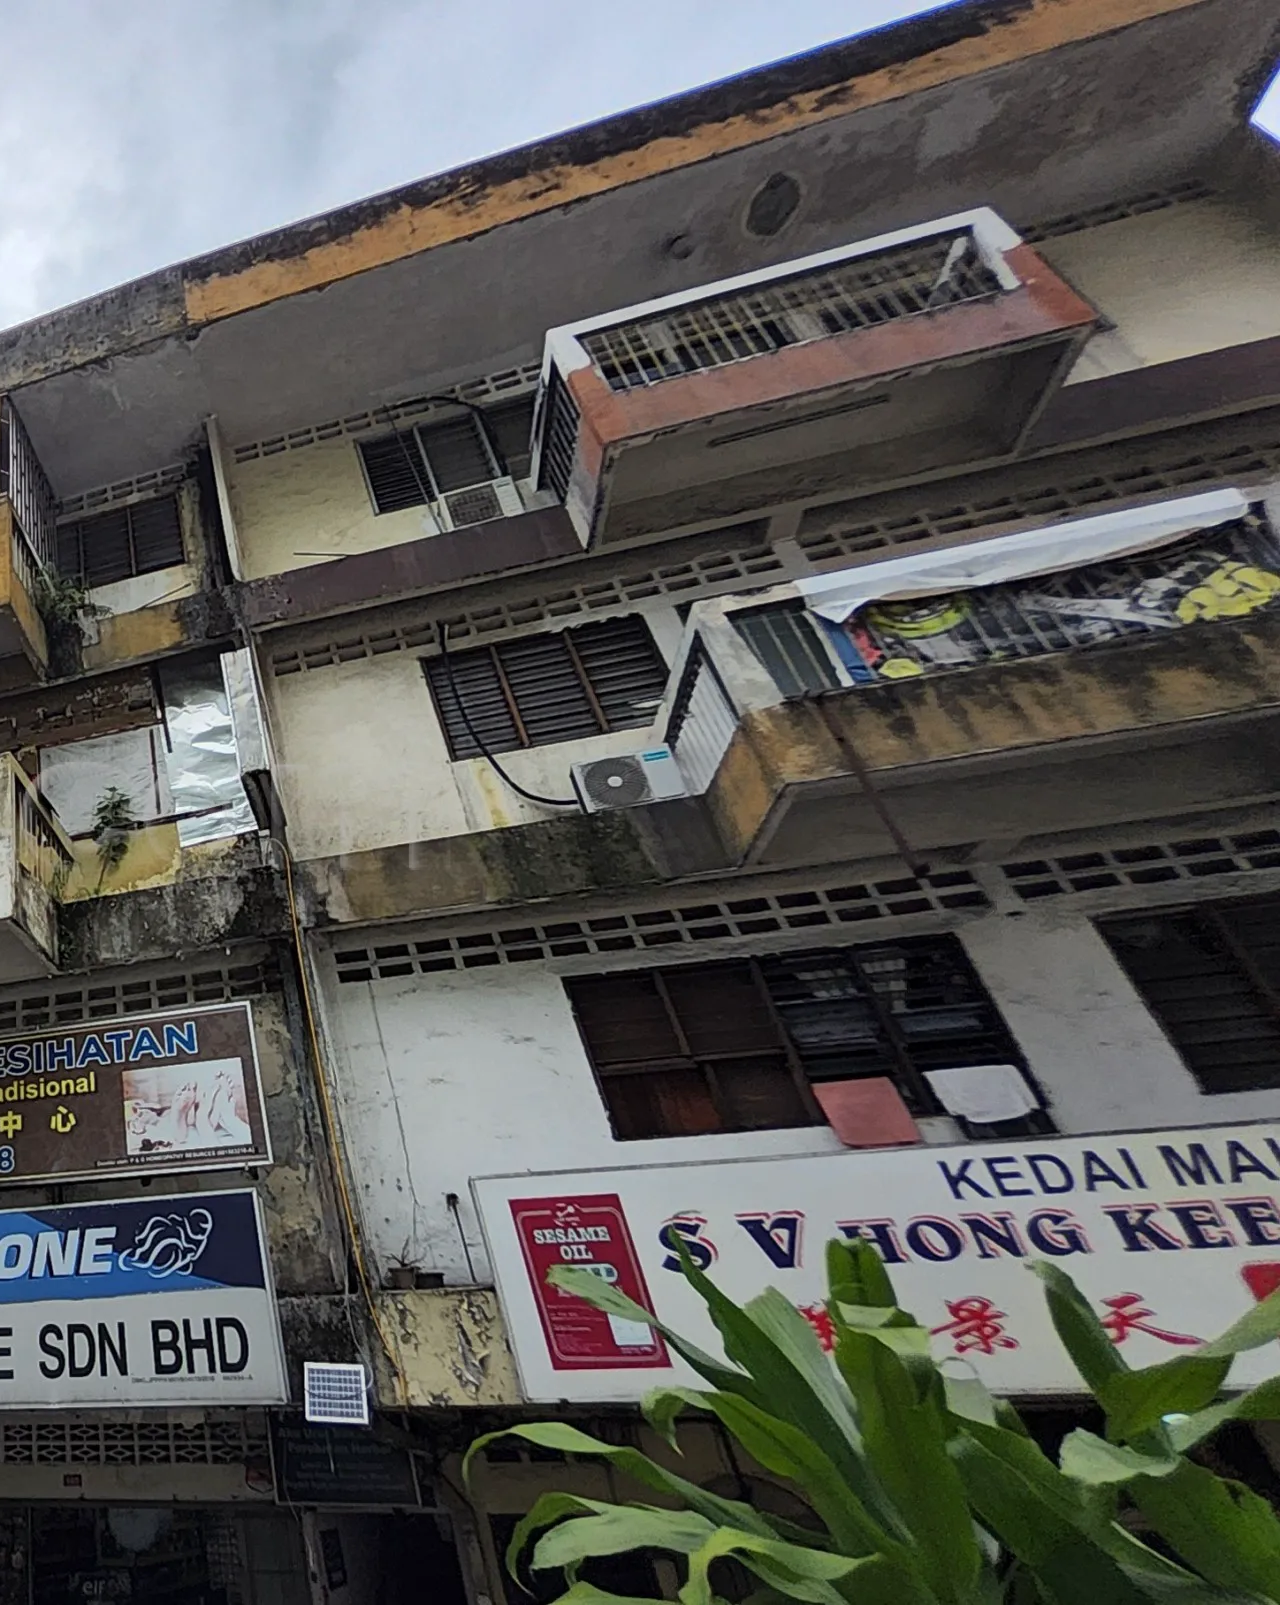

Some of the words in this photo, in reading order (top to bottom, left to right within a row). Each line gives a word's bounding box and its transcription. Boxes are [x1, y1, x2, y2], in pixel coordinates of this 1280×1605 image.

[937, 1148, 1148, 1200] KEDAI
[1156, 1136, 1280, 1188] MA
[533, 1225, 611, 1245] SESAME
[559, 1244, 594, 1261] OIL
[835, 1207, 1094, 1264] HONG
[38, 1321, 128, 1379] SDN
[151, 1316, 250, 1375] BHD
